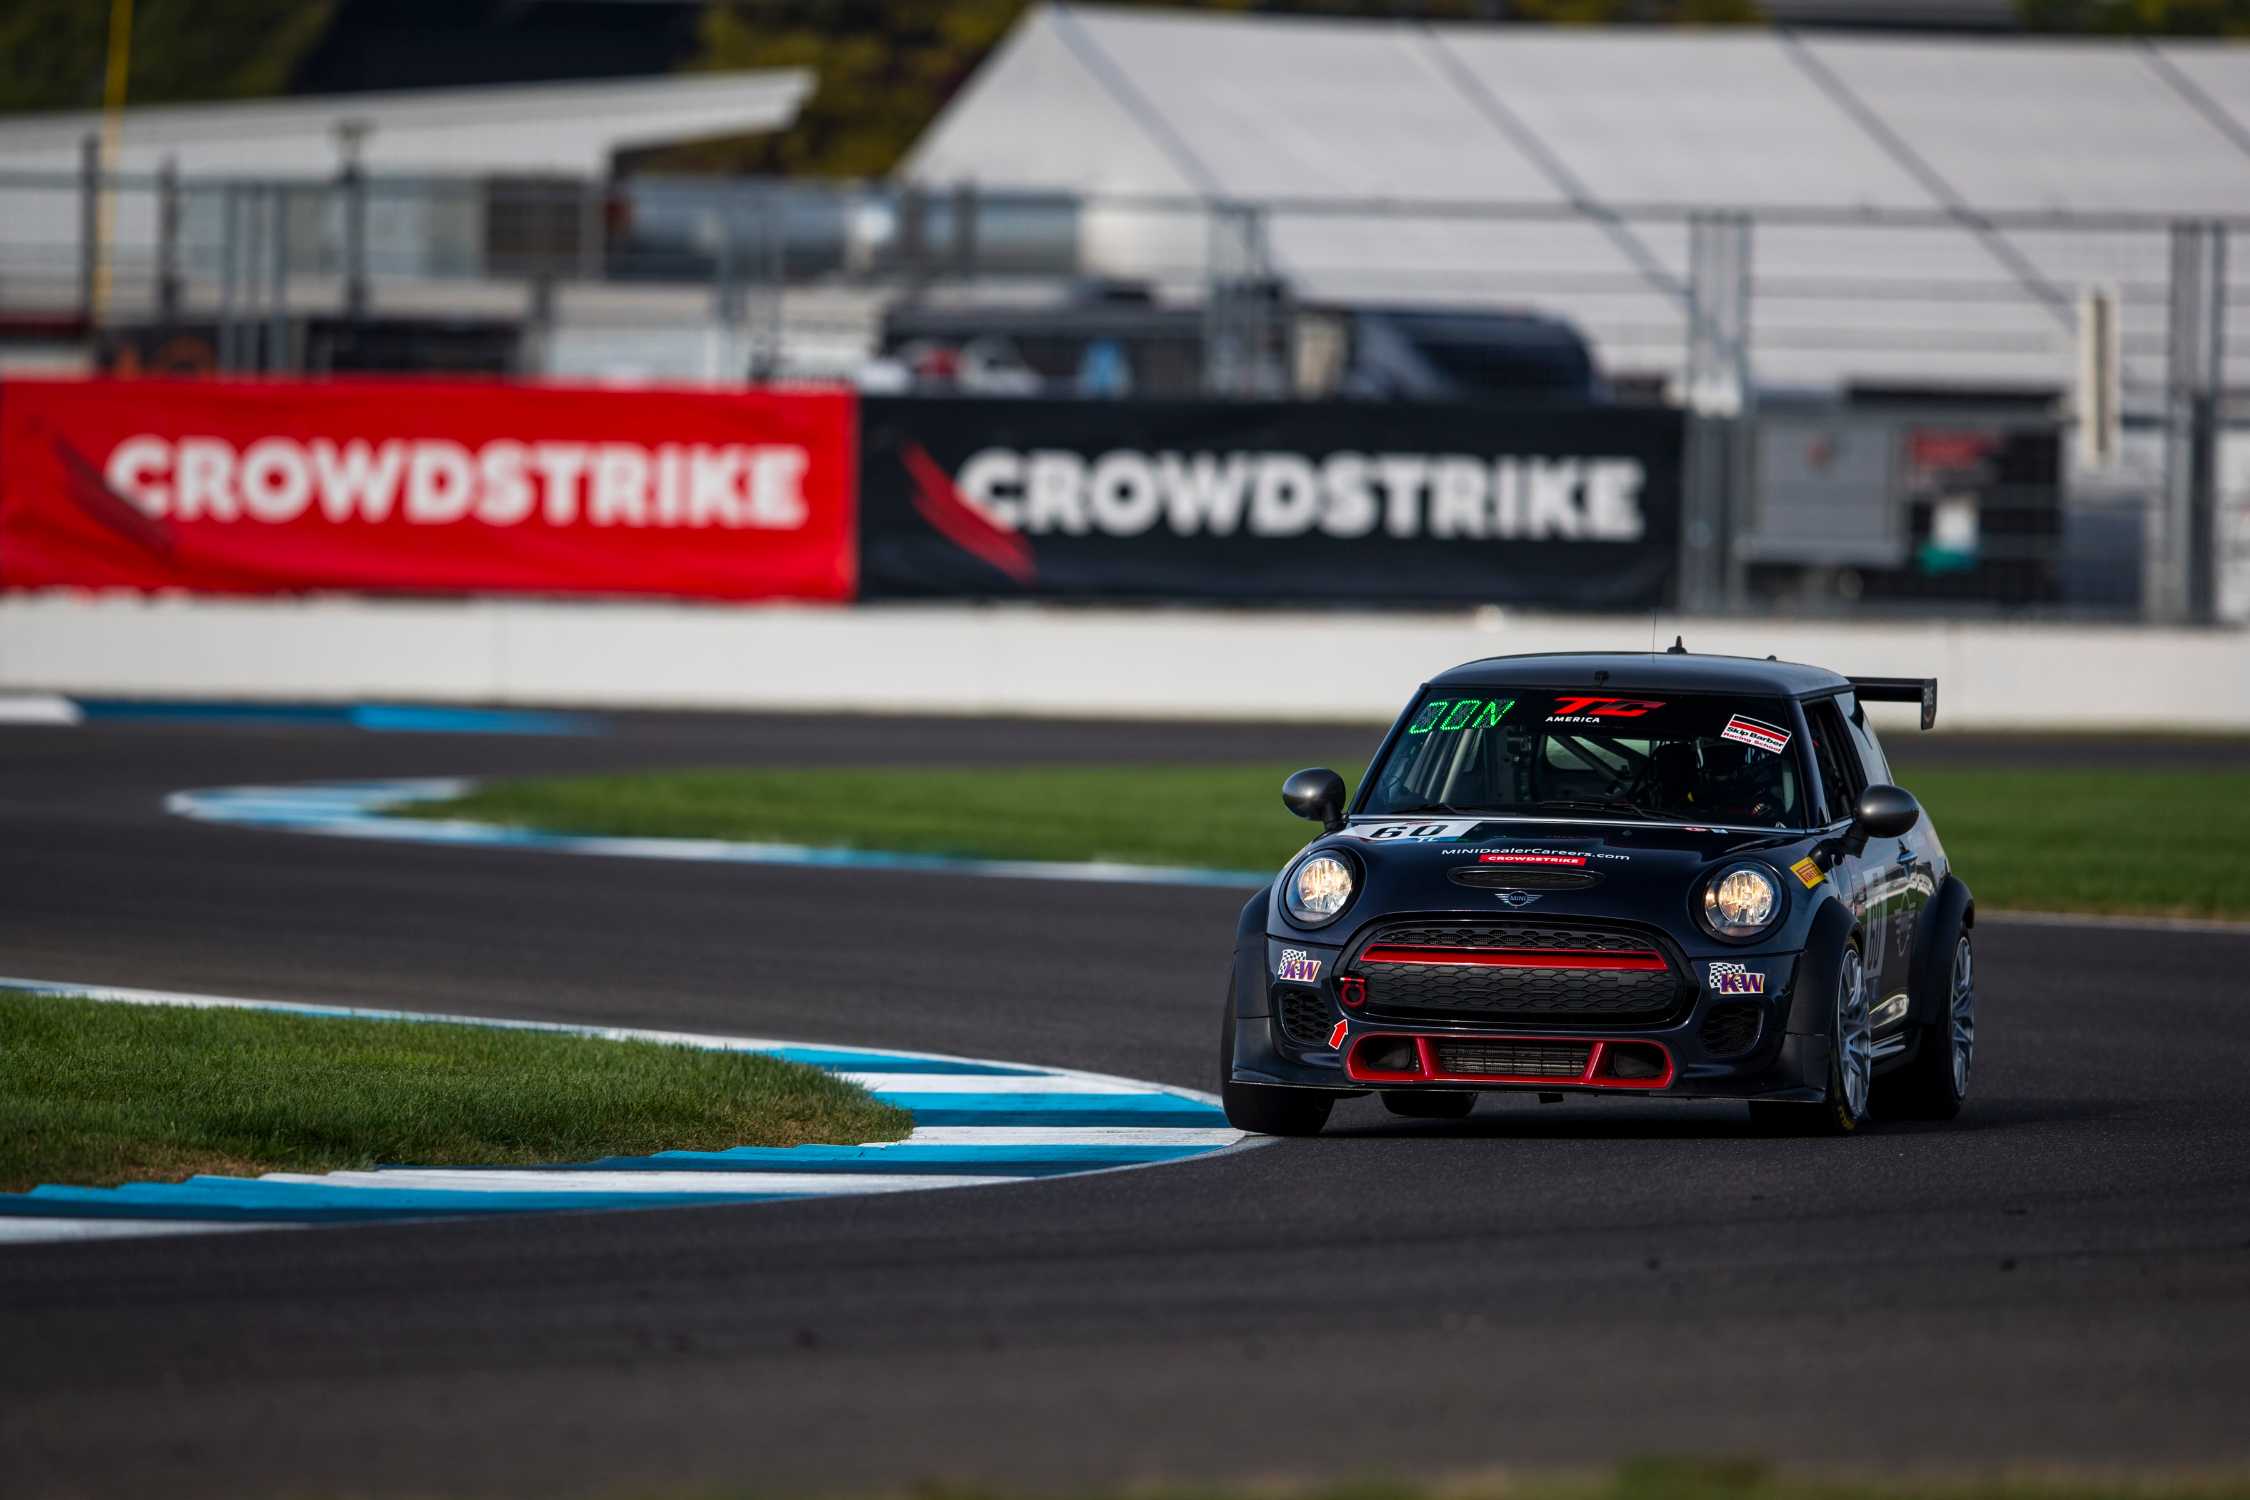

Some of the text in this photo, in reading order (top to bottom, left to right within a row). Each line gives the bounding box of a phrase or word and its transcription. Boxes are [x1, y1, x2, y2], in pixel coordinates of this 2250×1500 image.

[105, 434, 808, 528] CROWDSTRIKE
[956, 448, 1644, 538] CROWDSTRIKE
[1554, 697, 1666, 717] TC
[1726, 726, 1785, 748] Skip Barber
[1370, 825, 1449, 838] 60
[1442, 847, 1630, 861] MINIDealerCareers.com
[1487, 856, 1579, 864] CROWDSTRIKE
[1281, 959, 1320, 980] KW
[1720, 971, 1764, 993] KW
